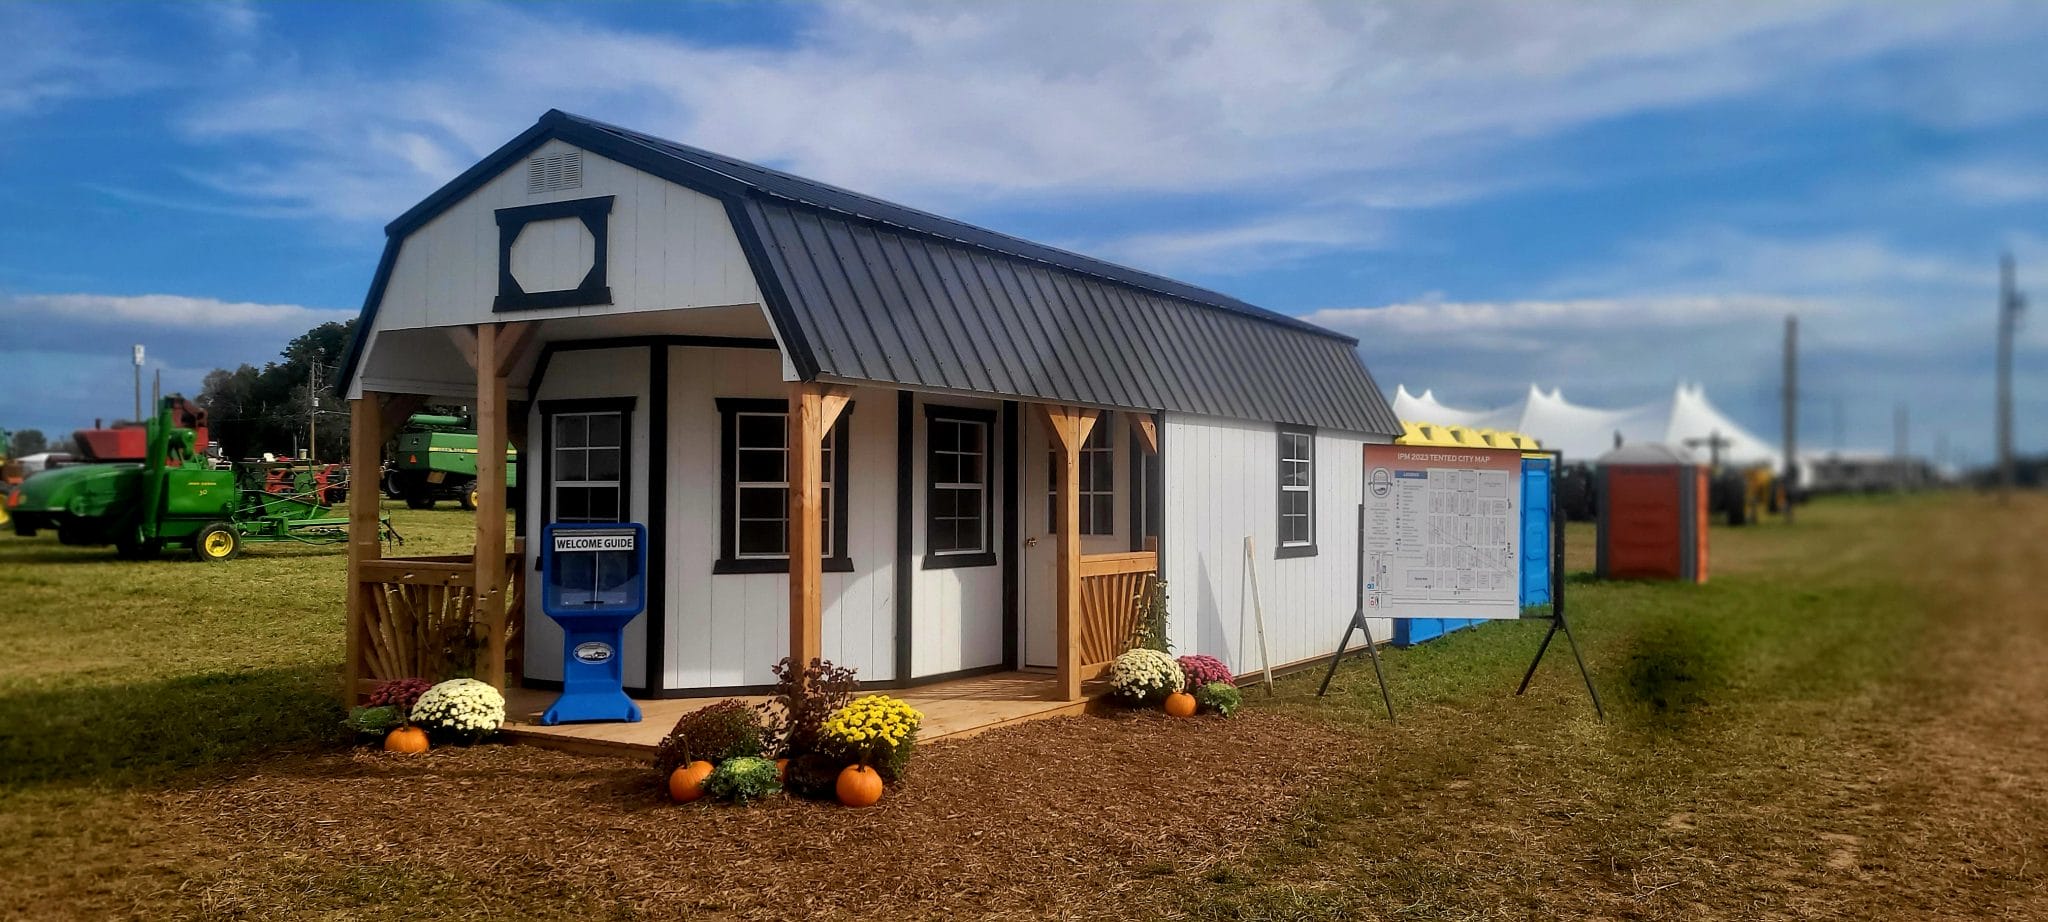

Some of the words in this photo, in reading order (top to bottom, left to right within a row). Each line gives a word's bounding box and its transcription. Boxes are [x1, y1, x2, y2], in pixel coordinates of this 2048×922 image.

[1411, 453, 1429, 461] 2023
[1430, 454, 1457, 462] TENTED
[556, 539, 603, 549] WELCOME
[604, 538, 633, 548] GUIDE
